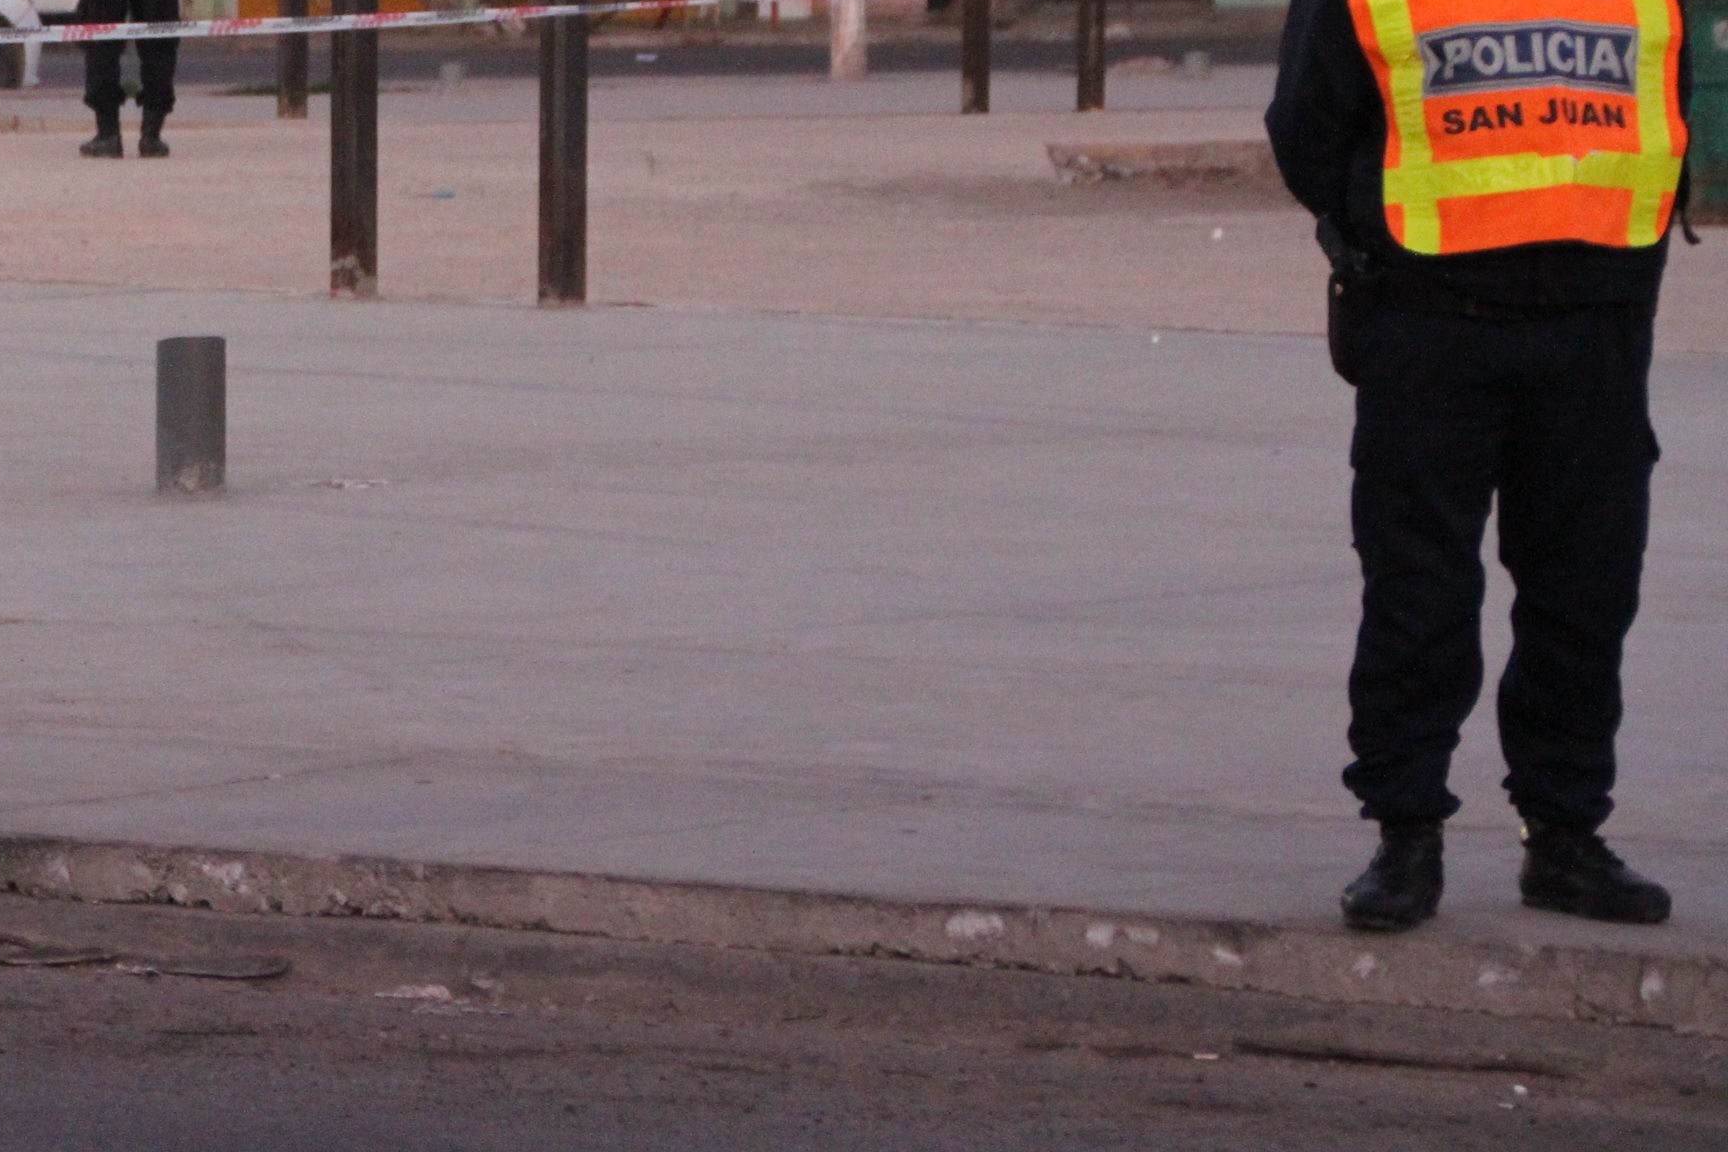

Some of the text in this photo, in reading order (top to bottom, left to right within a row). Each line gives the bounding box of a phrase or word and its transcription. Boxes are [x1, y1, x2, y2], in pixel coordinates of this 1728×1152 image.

[1443, 31, 1622, 80] POLICIA
[1442, 98, 1626, 135] SAN JUAN
